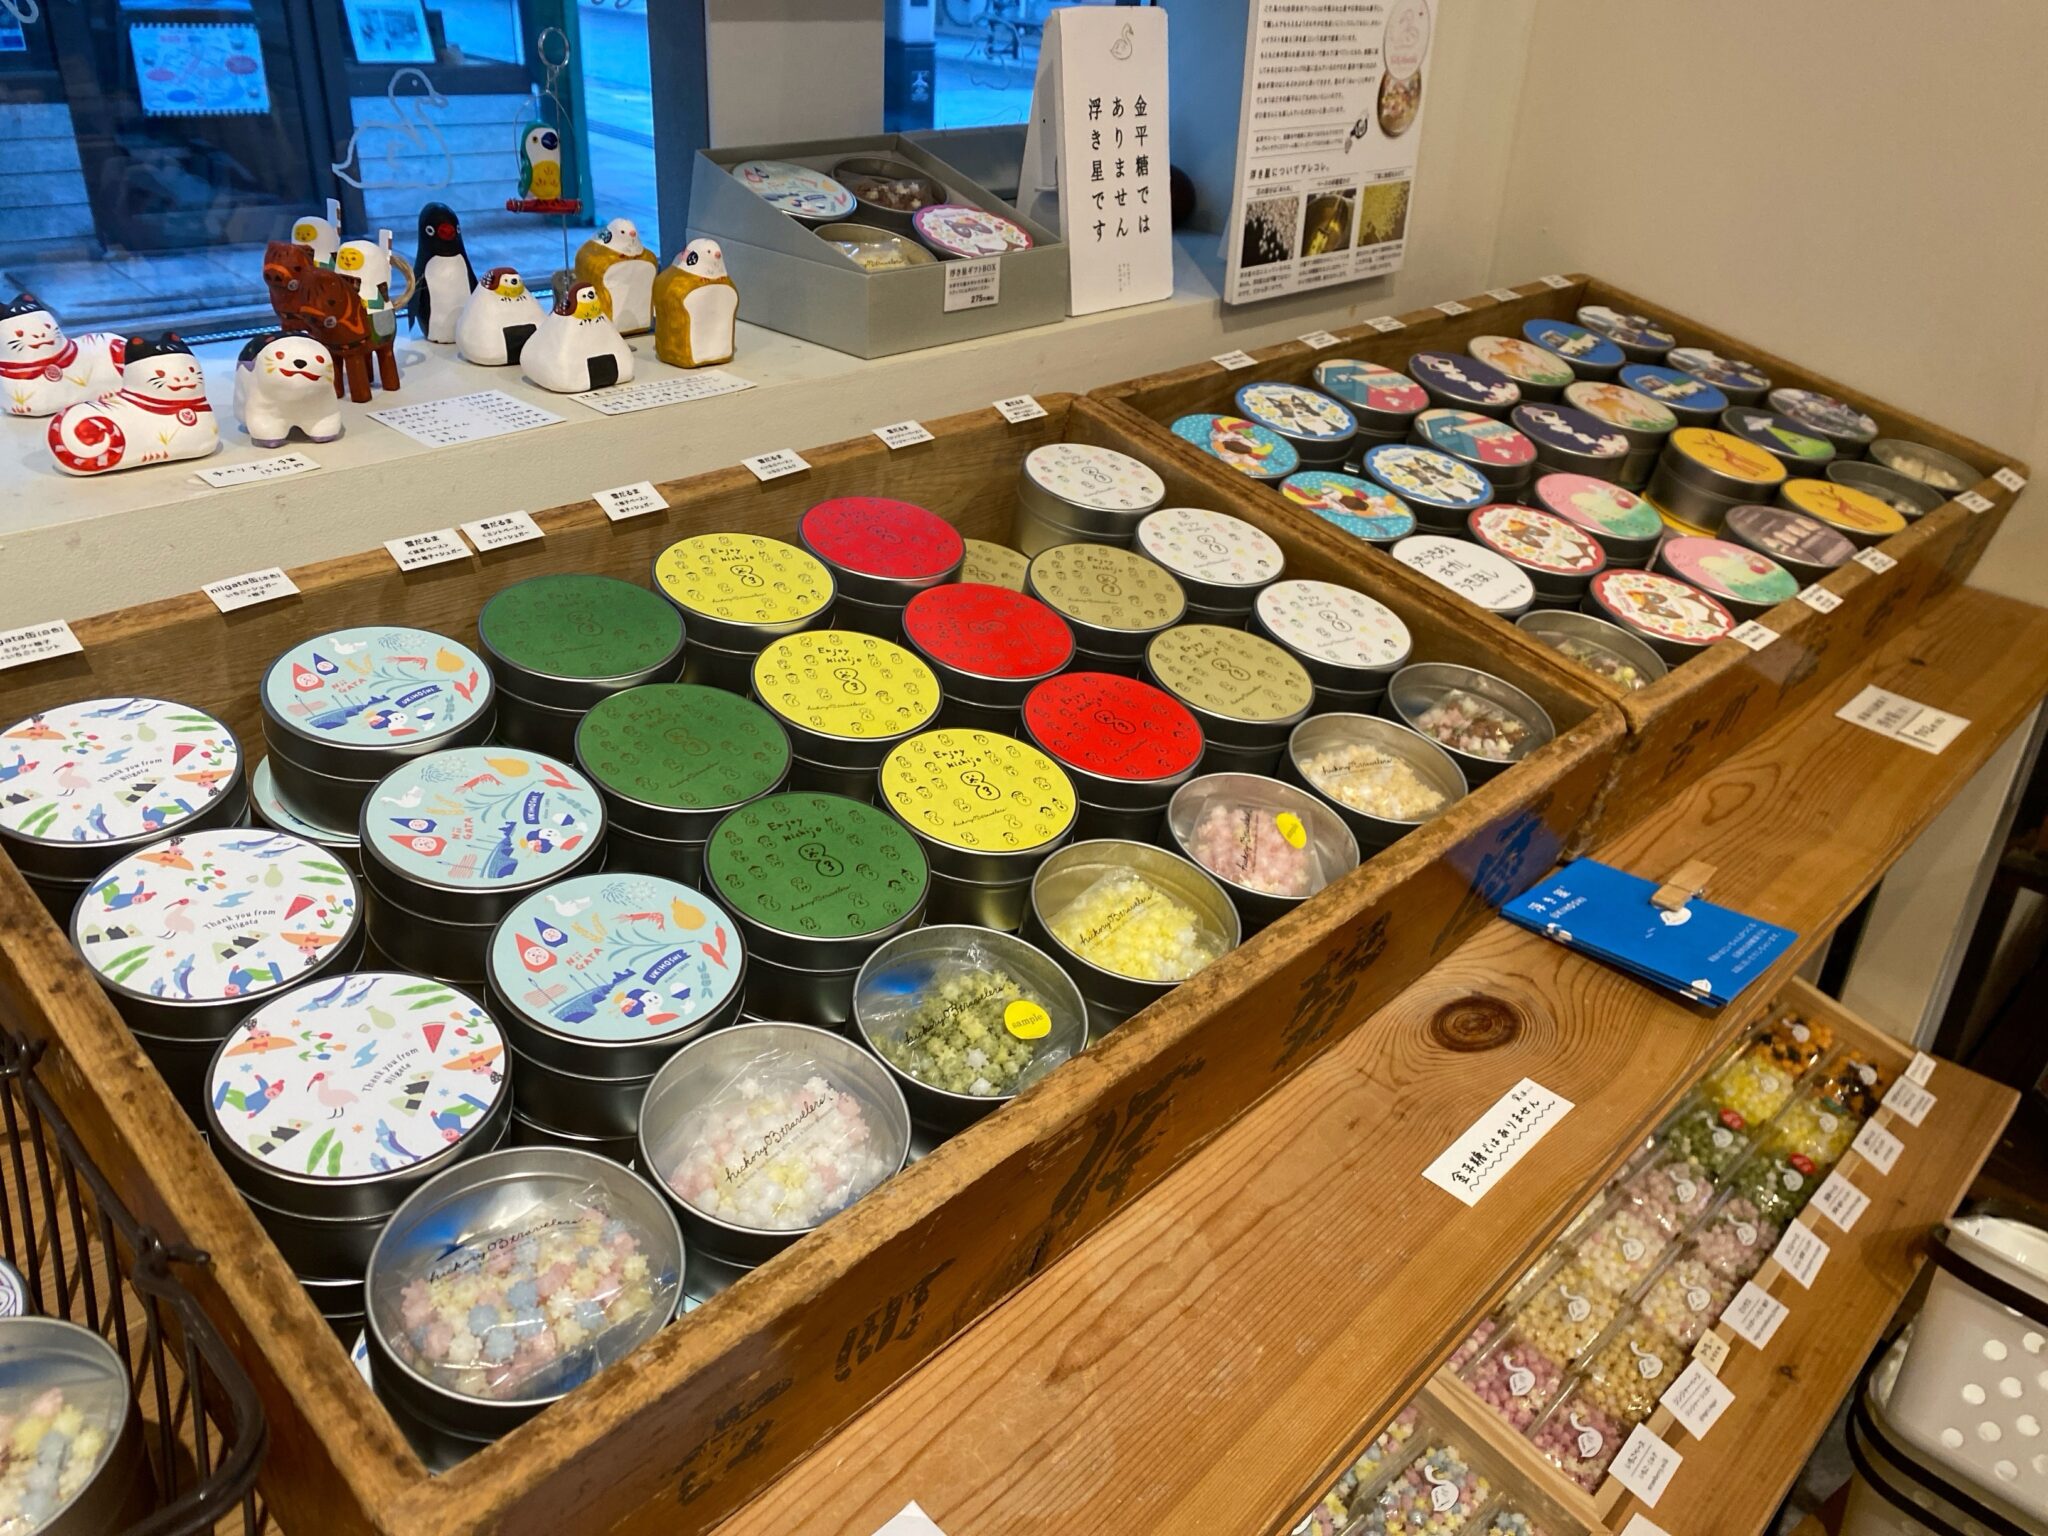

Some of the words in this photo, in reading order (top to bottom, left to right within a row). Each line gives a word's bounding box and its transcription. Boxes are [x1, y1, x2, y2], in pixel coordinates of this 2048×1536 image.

[1088, 98, 1105, 242] 浮き星です
[1112, 97, 1129, 238] ありません
[1134, 94, 1150, 233] 金平糖では
[611, 489, 640, 499] 雪だるま
[480, 518, 514, 530] 雪だるま
[405, 535, 440, 548] 雪だるま
[710, 547, 741, 556] Enjoy
[818, 647, 850, 657] Enjoy
[403, 686, 435, 705] UKIHOSHI
[933, 749, 966, 760] Enjoy
[97, 768, 123, 785] Thank
[126, 762, 140, 774] you
[141, 758, 163, 768] from
[946, 757, 982, 770] Nichijo
[120, 768, 150, 783] Niigata
[767, 818, 803, 832] Enjoy
[203, 914, 233, 931] Thank
[235, 911, 252, 922] you
[254, 908, 276, 917] from
[225, 918, 259, 932] Niigata
[575, 947, 603, 971] GATA
[649, 953, 682, 979] UKIHOSHI
[1012, 1013, 1044, 1029] sample
[362, 1071, 385, 1092] Thank
[382, 1060, 399, 1073] you
[396, 1048, 419, 1062] from
[384, 1062, 412, 1085] Niigata
[1451, 1100, 1540, 1184] 金平糖ではありません
